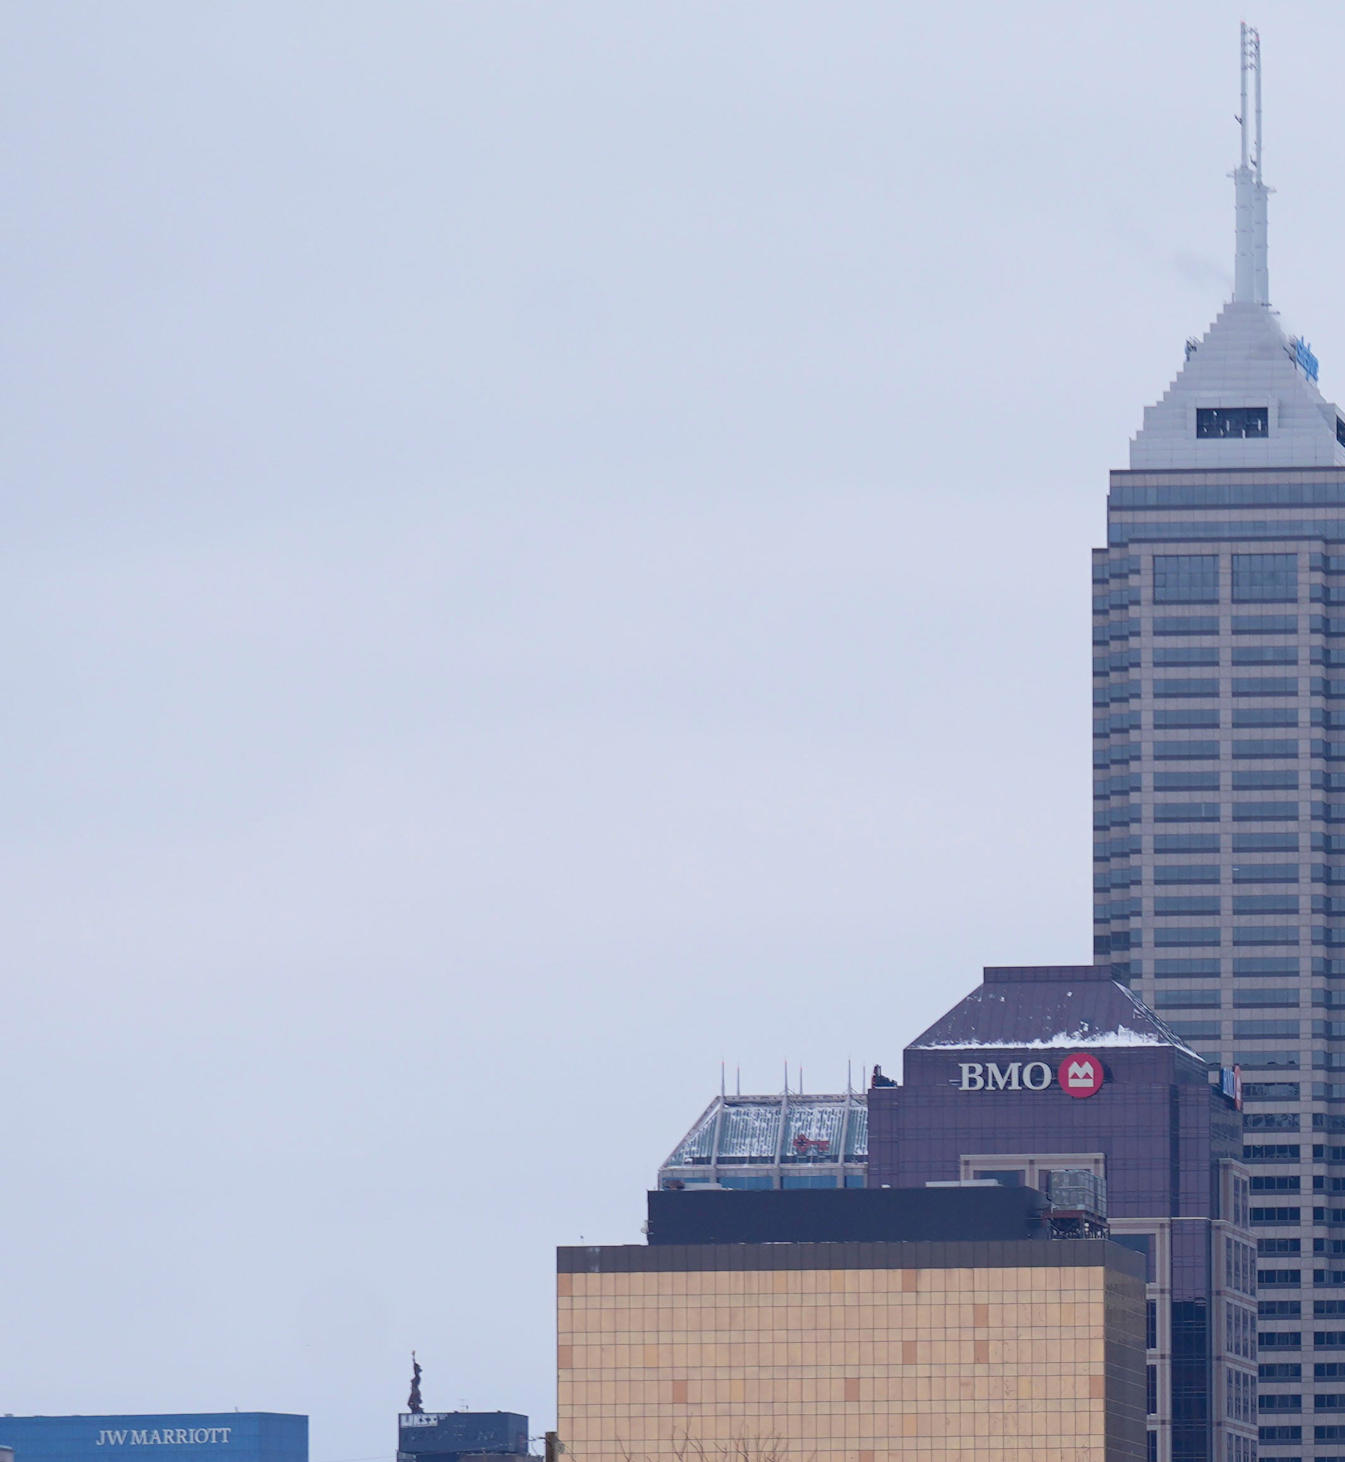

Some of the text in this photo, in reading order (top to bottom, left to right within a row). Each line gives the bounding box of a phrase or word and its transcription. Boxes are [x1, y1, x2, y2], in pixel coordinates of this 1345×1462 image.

[957, 1062, 1052, 1091] BMO
[96, 1427, 232, 1446] JW MARRIOTT
